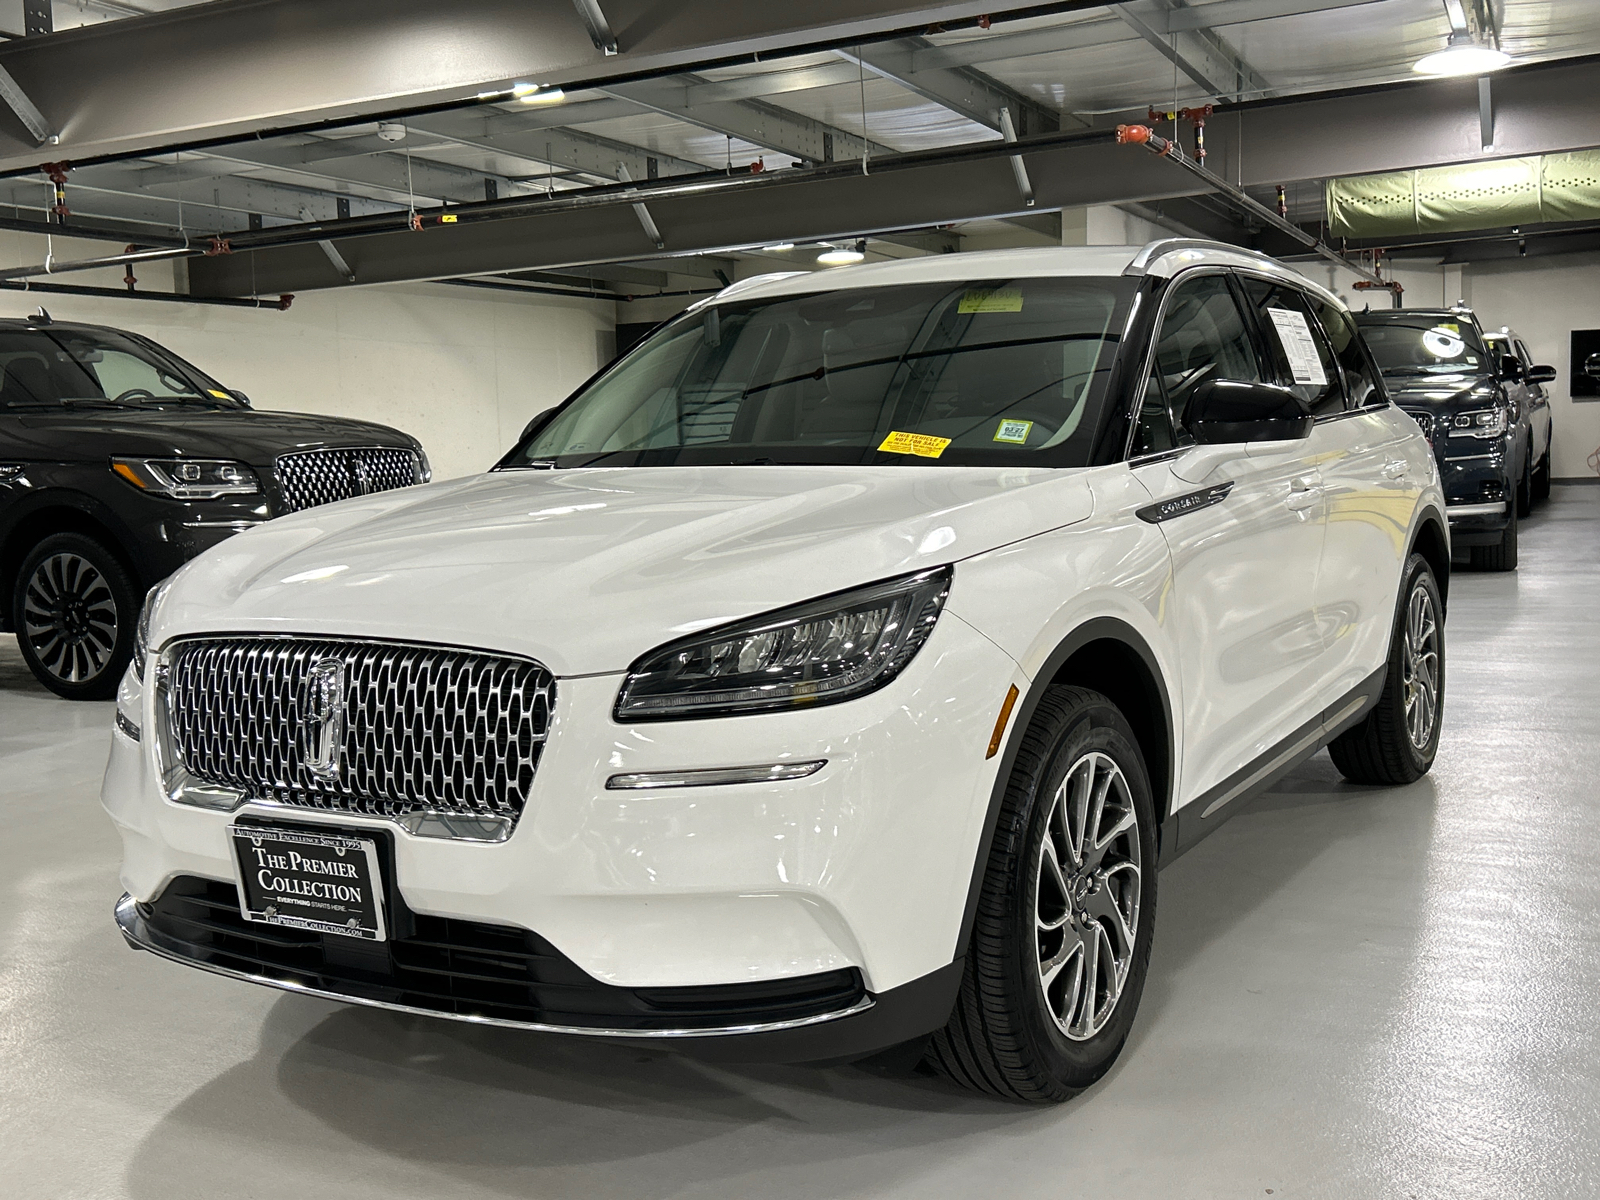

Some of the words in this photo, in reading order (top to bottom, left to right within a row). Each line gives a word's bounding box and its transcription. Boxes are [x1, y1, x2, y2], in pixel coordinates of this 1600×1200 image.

[911, 434, 938, 443] VEHICLE
[1160, 495, 1202, 514] CORSAIR
[236, 828, 278, 840] AUTOMOTIVE
[278, 832, 319, 847] EXCELLENCE
[320, 837, 340, 847] SINCE
[342, 839, 362, 849] 1995
[252, 847, 289, 870] THE
[288, 850, 359, 879] PREMIER
[257, 869, 363, 903] COLLECTION
[276, 896, 311, 907] EVERYTHING
[311, 900, 331, 910] STARTS
